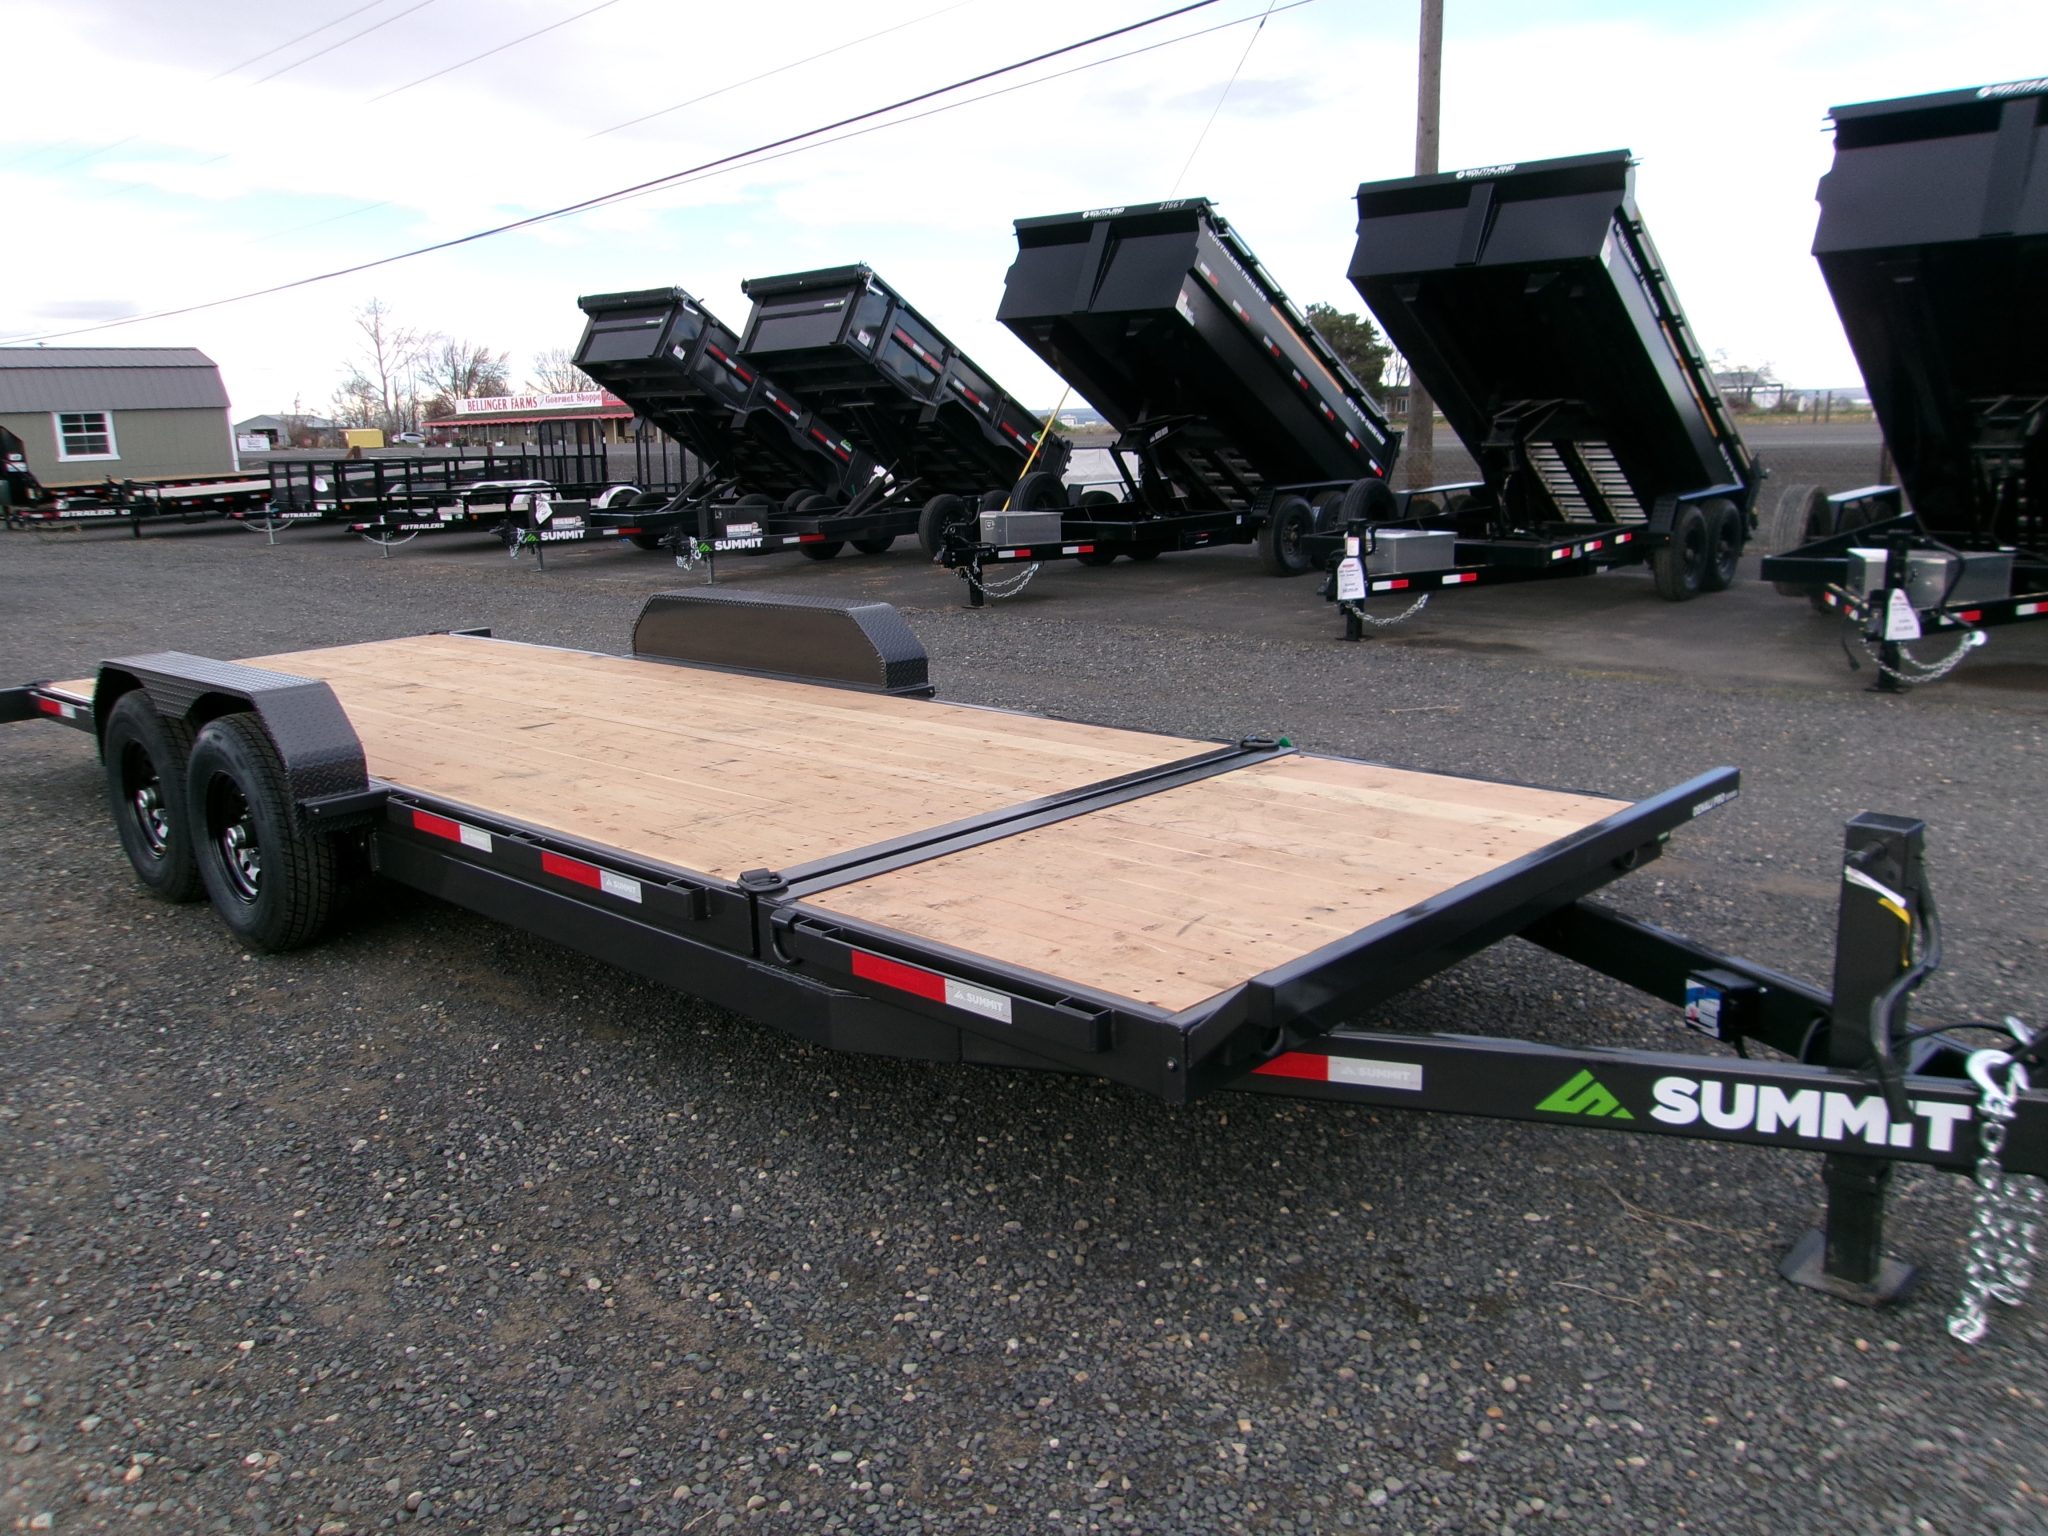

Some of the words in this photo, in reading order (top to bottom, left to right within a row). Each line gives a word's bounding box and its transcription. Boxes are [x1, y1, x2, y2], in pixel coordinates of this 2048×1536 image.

[467, 398, 507, 412] BELLINGER
[511, 396, 538, 409] FARMS
[541, 530, 585, 541] SUMMIT
[715, 538, 763, 550] SUMMIT
[966, 992, 1003, 1011] SUMMIT
[1359, 1067, 1411, 1080] SUMMIT
